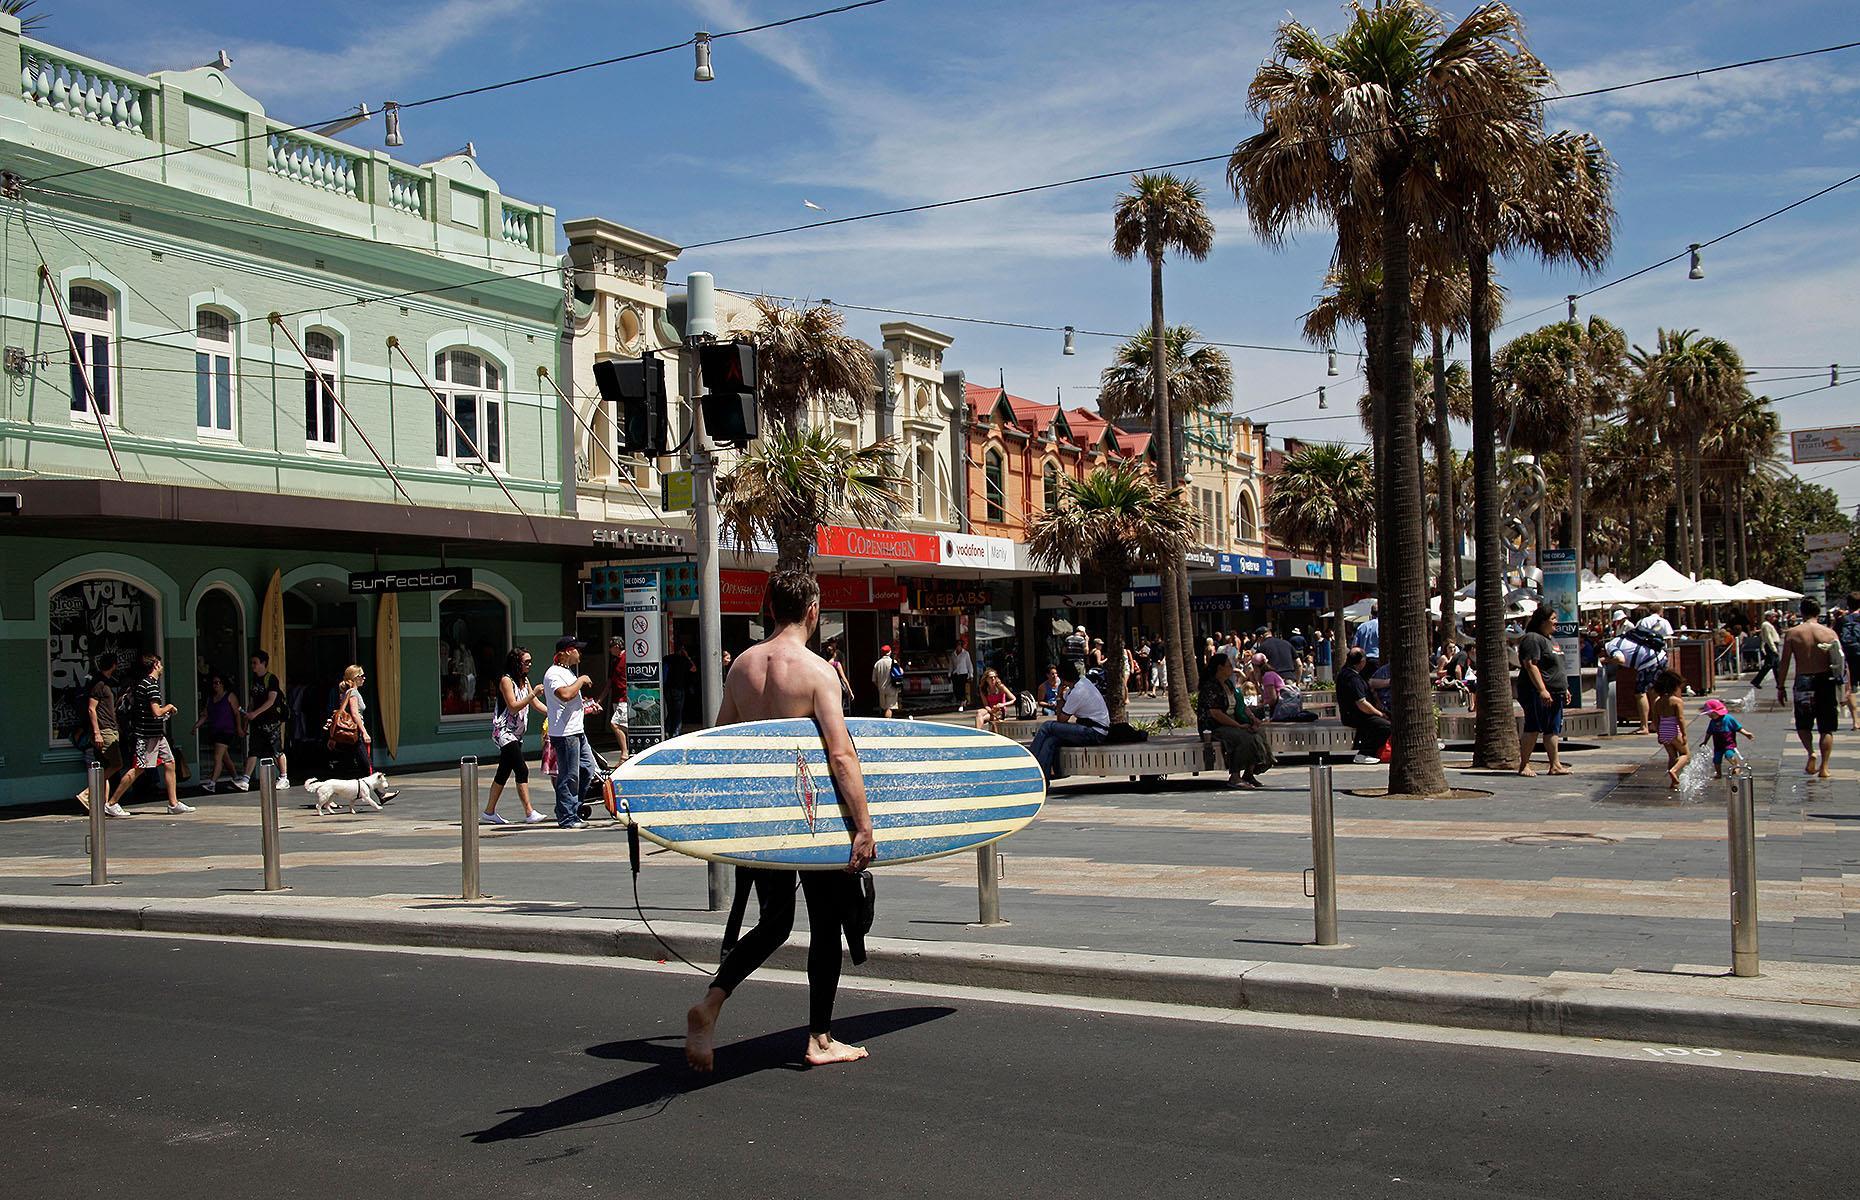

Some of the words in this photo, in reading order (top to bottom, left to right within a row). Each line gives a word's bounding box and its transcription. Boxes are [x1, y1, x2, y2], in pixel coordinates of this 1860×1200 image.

[956, 543, 985, 558] vodafone
[991, 545, 1007, 562] Manly
[631, 576, 646, 585] CORSO
[871, 591, 900, 600] odafone
[924, 591, 986, 607] KEBABS
[1555, 623, 1577, 634] anly
[627, 664, 658, 676] manly
[1641, 1047, 1722, 1057] 100
